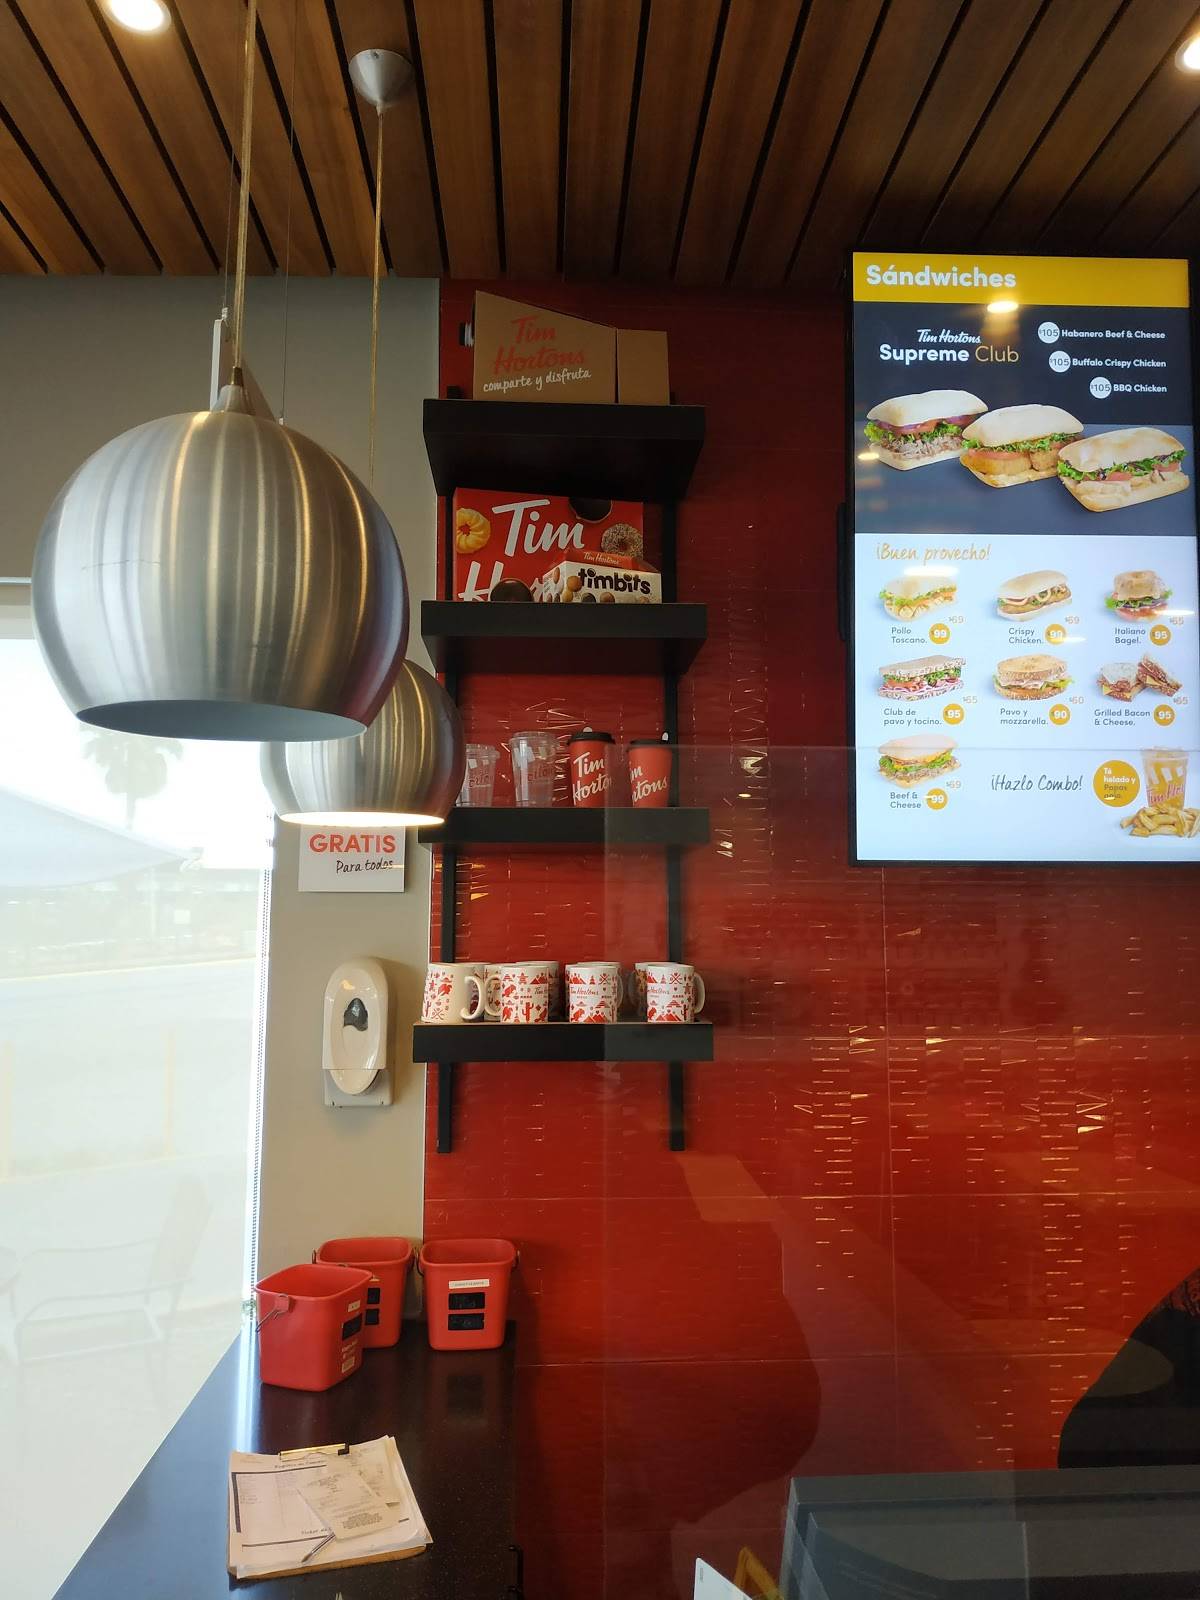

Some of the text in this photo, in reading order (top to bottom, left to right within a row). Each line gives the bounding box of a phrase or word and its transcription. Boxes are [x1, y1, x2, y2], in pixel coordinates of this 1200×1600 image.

[866, 264, 1016, 287] Sándwiches
[511, 315, 556, 344] Tim
[1061, 329, 1104, 338] Habanero
[1105, 330, 1125, 338] Beef
[1134, 330, 1166, 339] Cheese
[916, 328, 982, 344] Tim Hortons
[879, 343, 1019, 365] Supreme Club
[493, 345, 588, 375] Hortons
[1072, 358, 1103, 366] Buffalo
[1104, 358, 1131, 368] Crispy
[1133, 359, 1167, 367] Chicken
[483, 367, 592, 394] comparte y disfruta
[1113, 384, 1132, 392] BBQ
[1133, 384, 1168, 393] Chicken
[491, 499, 586, 558] Tim
[876, 542, 991, 565] ¡Buen provecho!
[577, 567, 652, 595] timbits
[891, 626, 912, 635] Pollo
[1008, 627, 1035, 638] Crispy
[1114, 627, 1146, 636] Italiano
[891, 636, 928, 644] Toscano.
[1008, 636, 1044, 645] Chicken.
[1114, 636, 1142, 646] Bagel.
[883, 707, 916, 716] Club de
[1000, 707, 1028, 719] Pavo y
[1094, 709, 1151, 718] Grilled Bacon
[883, 718, 905, 728] pavo
[906, 718, 912, 728] y
[914, 716, 943, 726] tocino.
[1000, 717, 1049, 726] mozzarella.
[1094, 719, 1101, 727] &
[1102, 719, 1136, 727] Cheese.
[573, 751, 605, 778] Tim
[991, 774, 1084, 792] ¡Hazlo Combo!
[1103, 784, 1128, 793] Papas
[890, 791, 918, 800] Beef &
[890, 802, 921, 810] Cheese
[309, 833, 397, 853] GRATIS
[336, 857, 394, 873] Para todos
